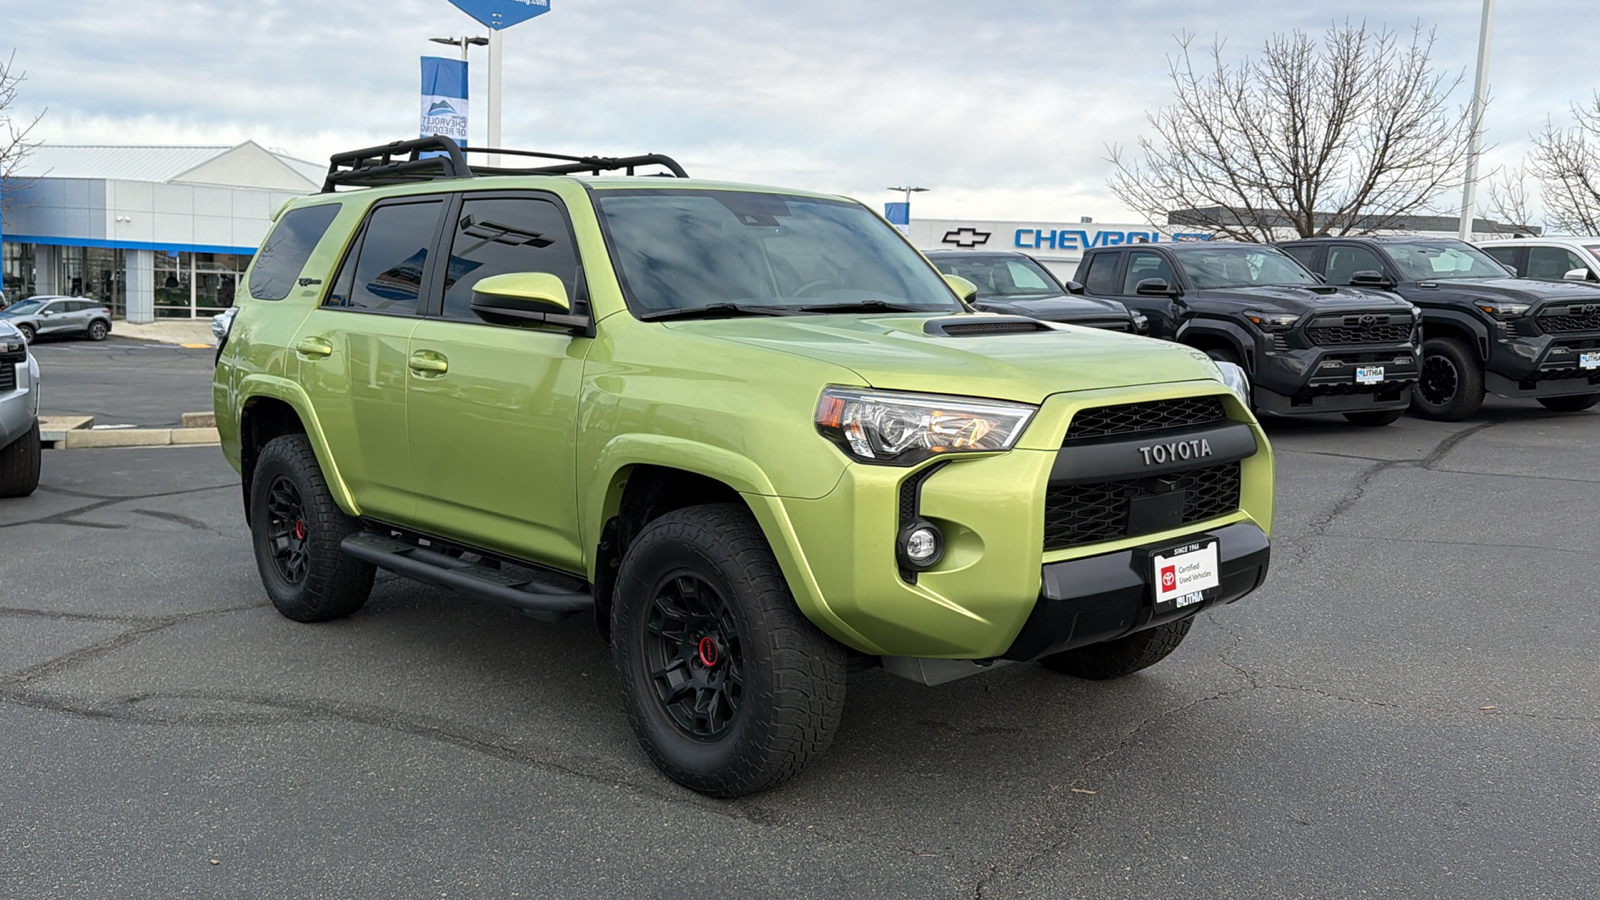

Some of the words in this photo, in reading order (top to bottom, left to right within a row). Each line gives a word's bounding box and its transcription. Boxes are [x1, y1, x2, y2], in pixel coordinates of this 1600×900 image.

[1362, 368, 1383, 377] LITHIA
[1139, 439, 1212, 465] TOYOTA
[1173, 545, 1188, 556] SINCE
[1178, 562, 1200, 574] Certified
[1179, 574, 1192, 584] Used
[1192, 570, 1212, 581] Vehicles
[1182, 591, 1204, 606] LITHIA
